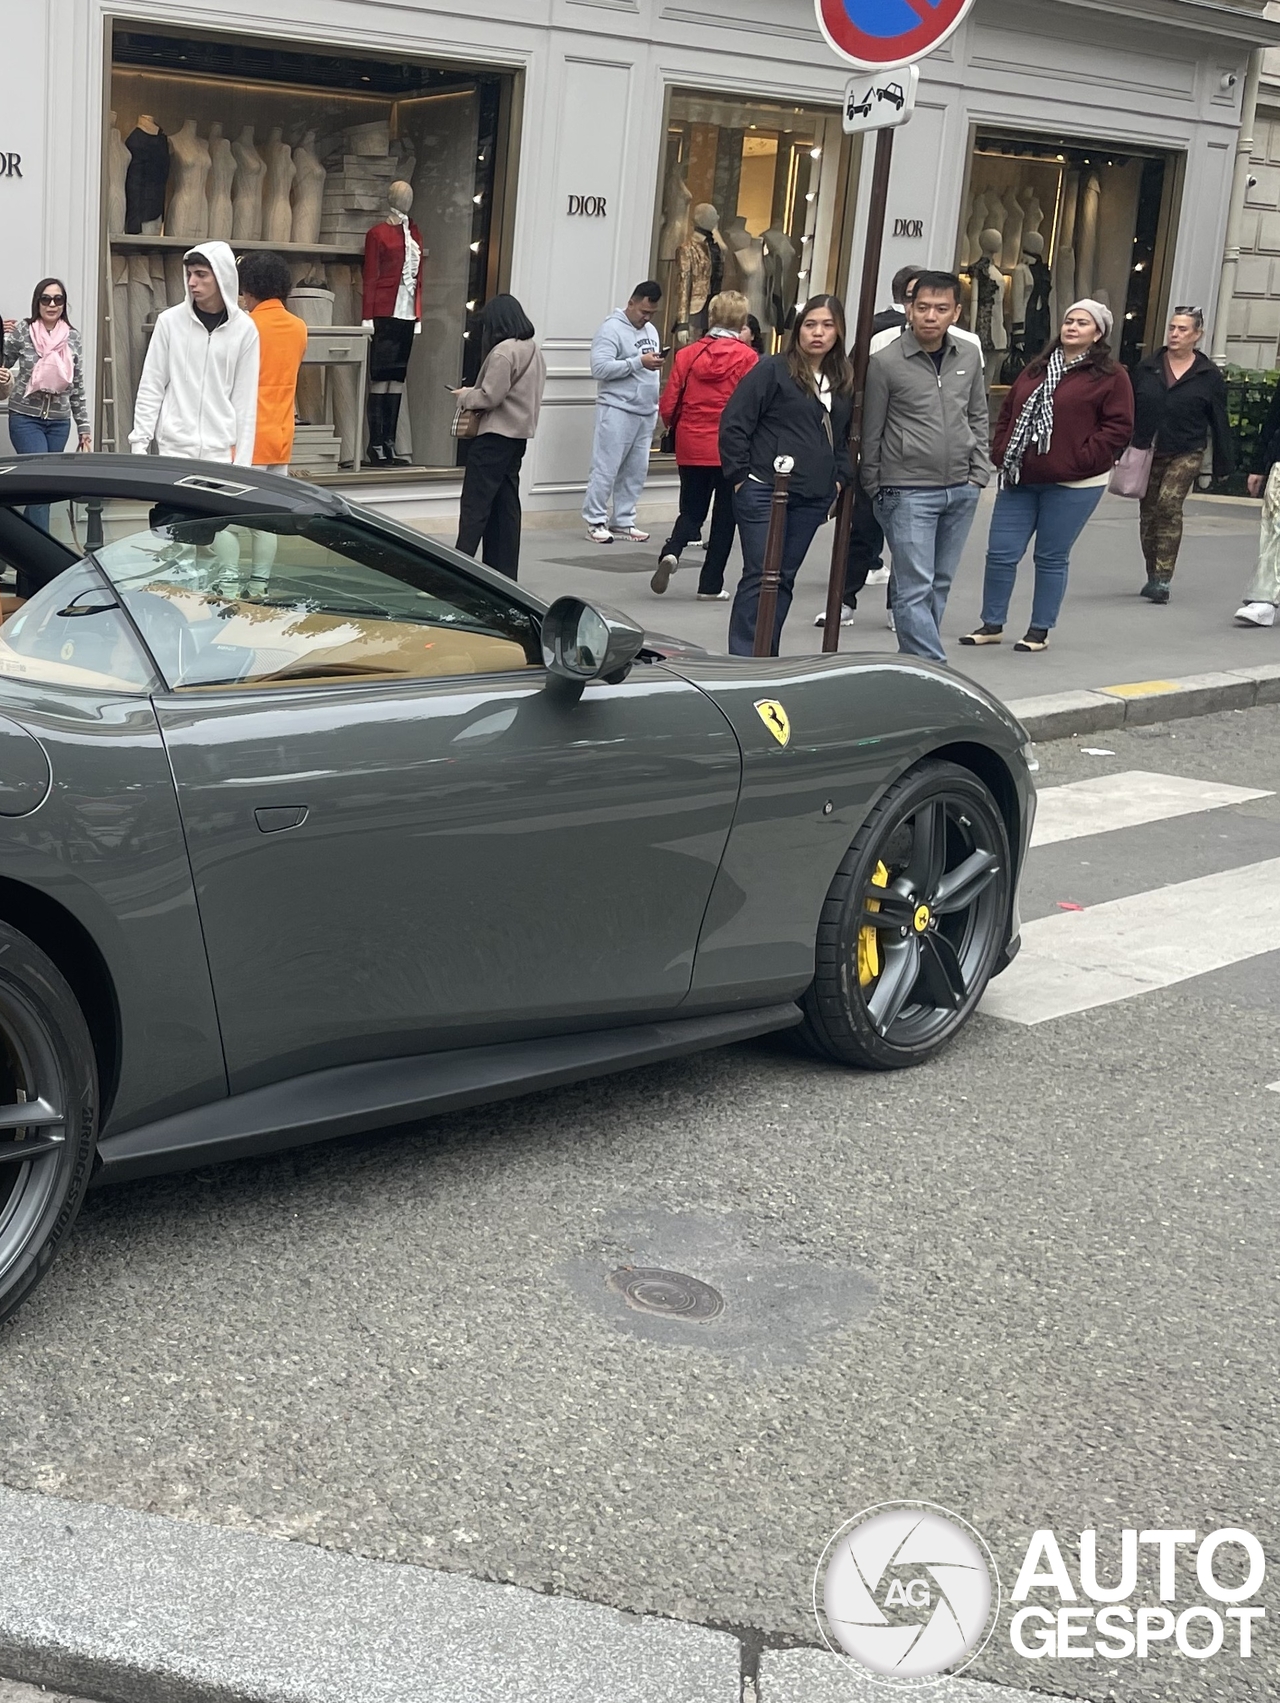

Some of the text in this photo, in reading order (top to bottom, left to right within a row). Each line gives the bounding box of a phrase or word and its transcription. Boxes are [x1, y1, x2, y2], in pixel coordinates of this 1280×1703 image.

[567, 194, 607, 217] DIOR
[892, 218, 923, 237] DIOR
[45, 1106, 93, 1252] BRIDGESTONE
